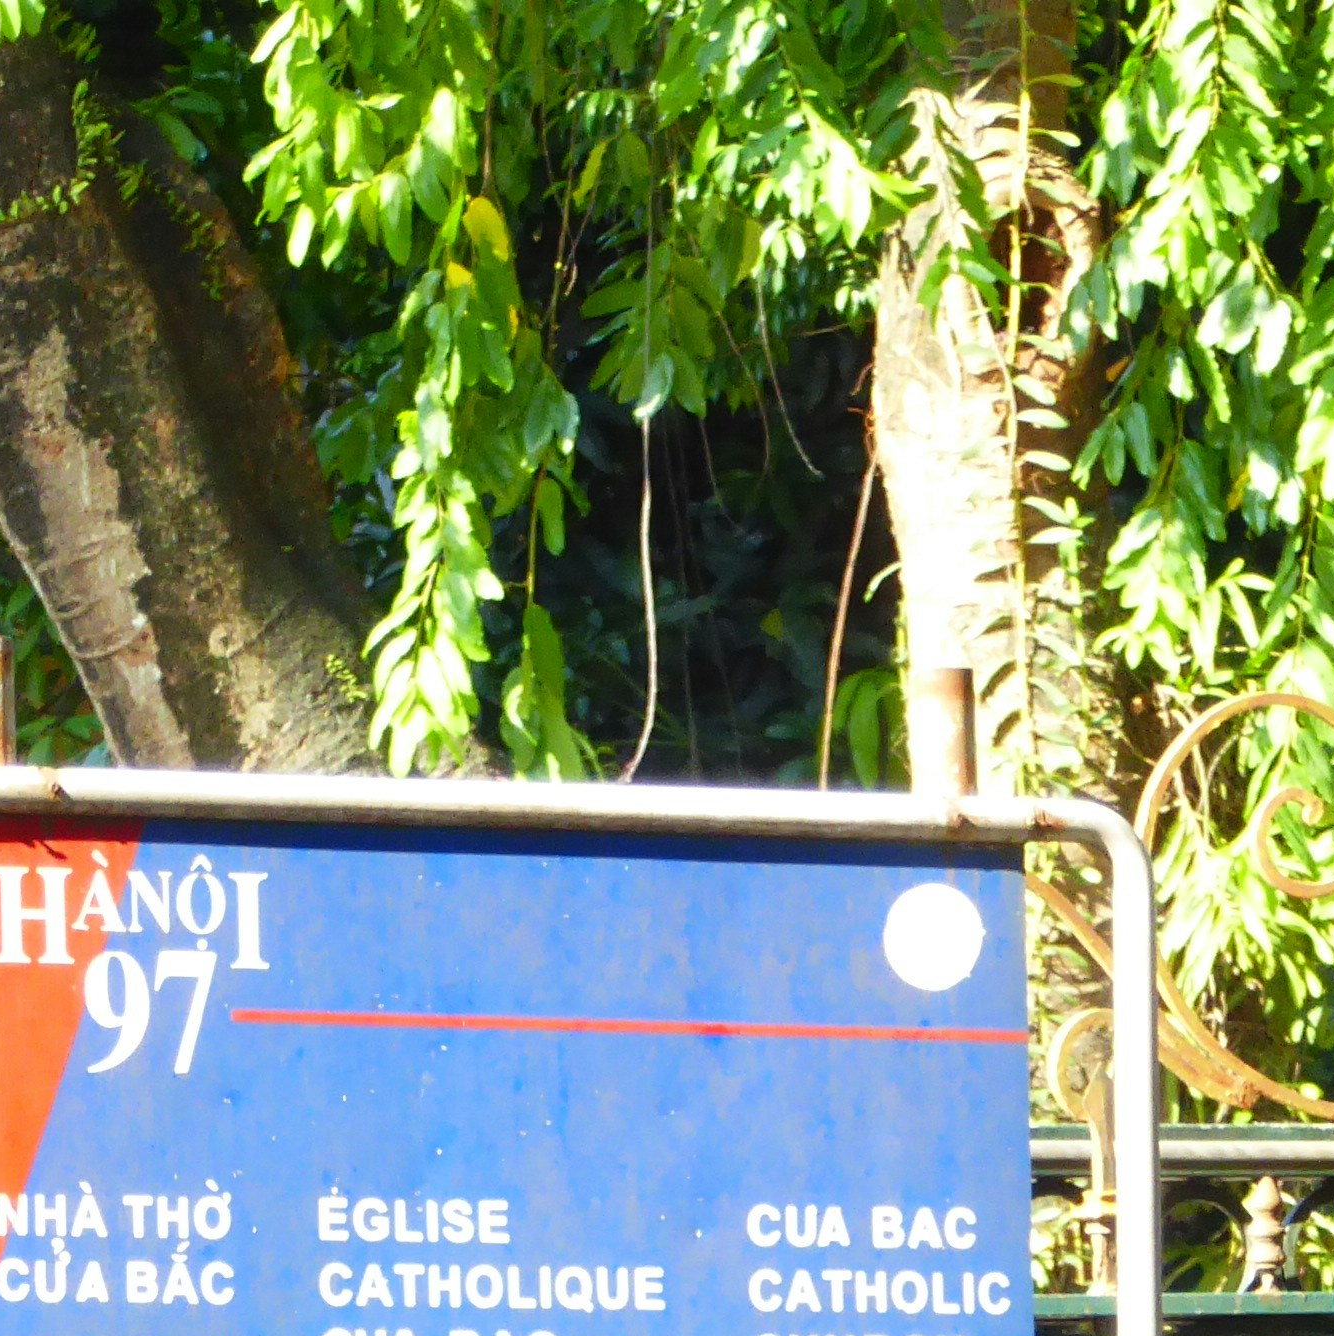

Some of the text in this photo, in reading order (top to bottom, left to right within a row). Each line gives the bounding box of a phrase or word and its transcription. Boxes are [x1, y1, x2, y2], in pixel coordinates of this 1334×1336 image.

[84, 951, 217, 1074] 97
[123, 1178, 232, 1240] THỜ
[747, 1204, 977, 1250] CUA BAC
[126, 1241, 235, 1305] BẮC
[319, 1262, 666, 1314] CATHOLIQUE
[748, 1268, 1011, 1316] CATHOLIC
